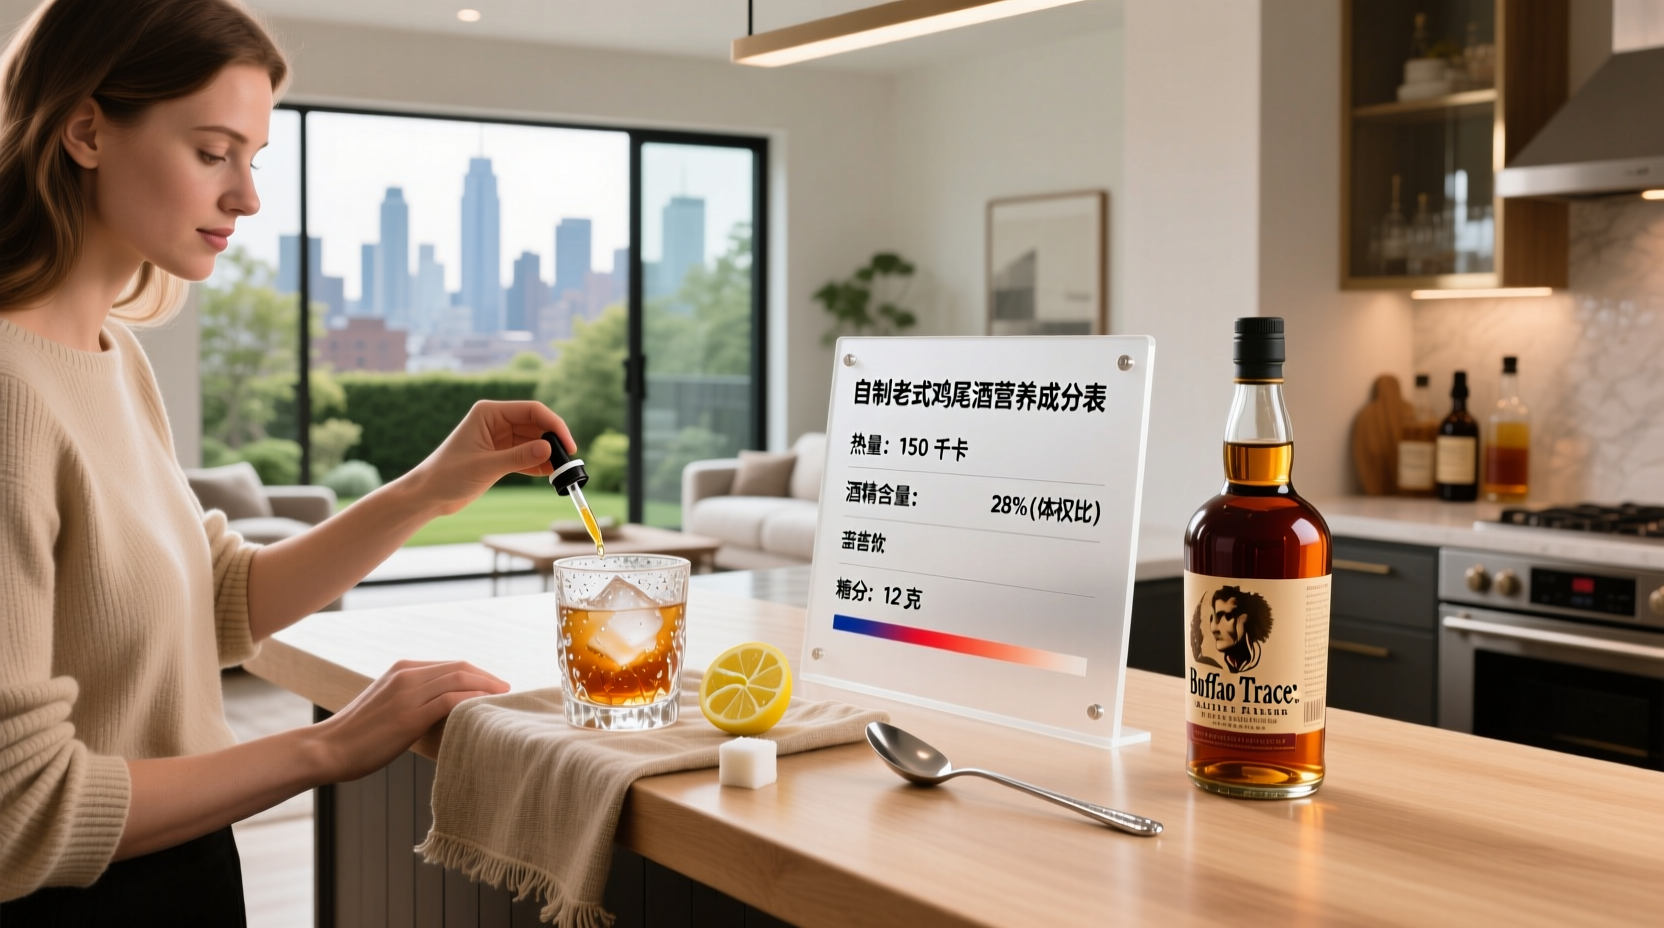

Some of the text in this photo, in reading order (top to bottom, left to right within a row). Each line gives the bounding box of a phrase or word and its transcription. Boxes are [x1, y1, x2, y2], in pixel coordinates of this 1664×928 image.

[855, 379, 1107, 413] 自制老式鸡尾酒营养成分表
